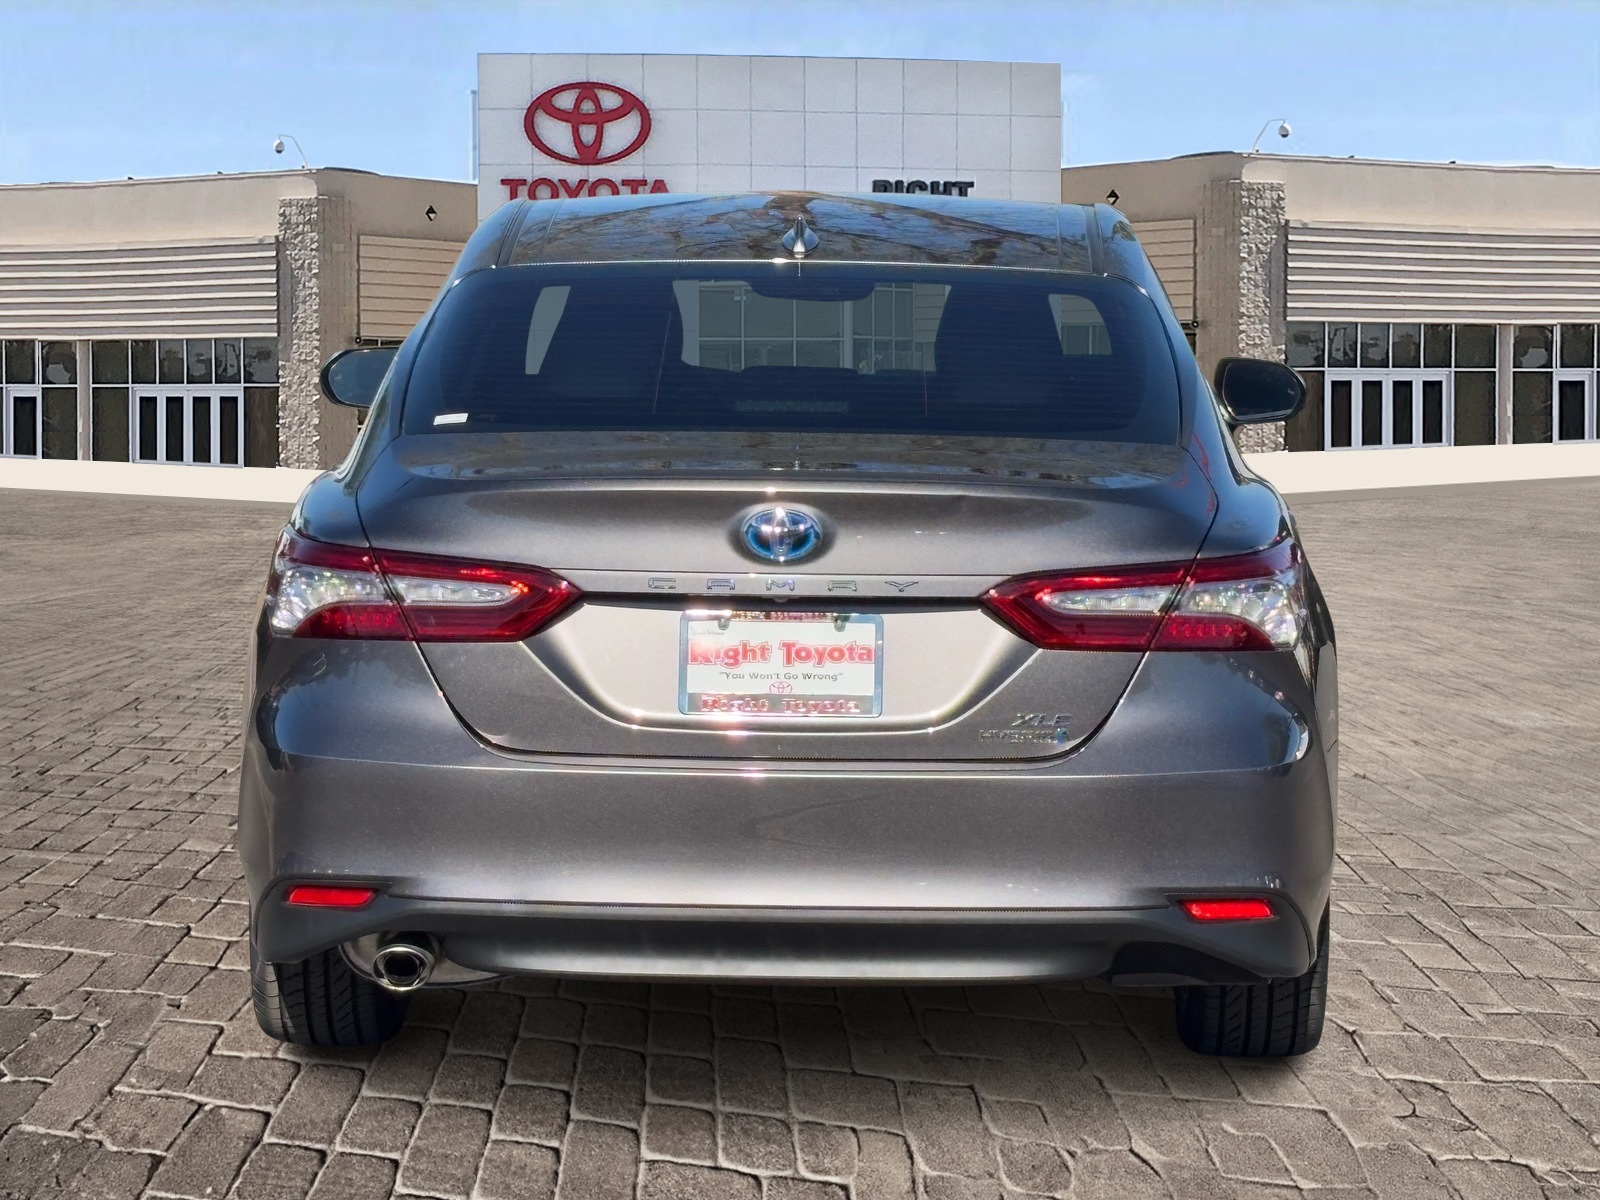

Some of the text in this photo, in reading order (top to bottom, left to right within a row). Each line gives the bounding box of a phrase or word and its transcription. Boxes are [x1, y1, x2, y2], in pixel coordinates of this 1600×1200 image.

[648, 577, 920, 593] CAMRY
[779, 640, 876, 668] Toyota
[783, 672, 799, 680] Go
